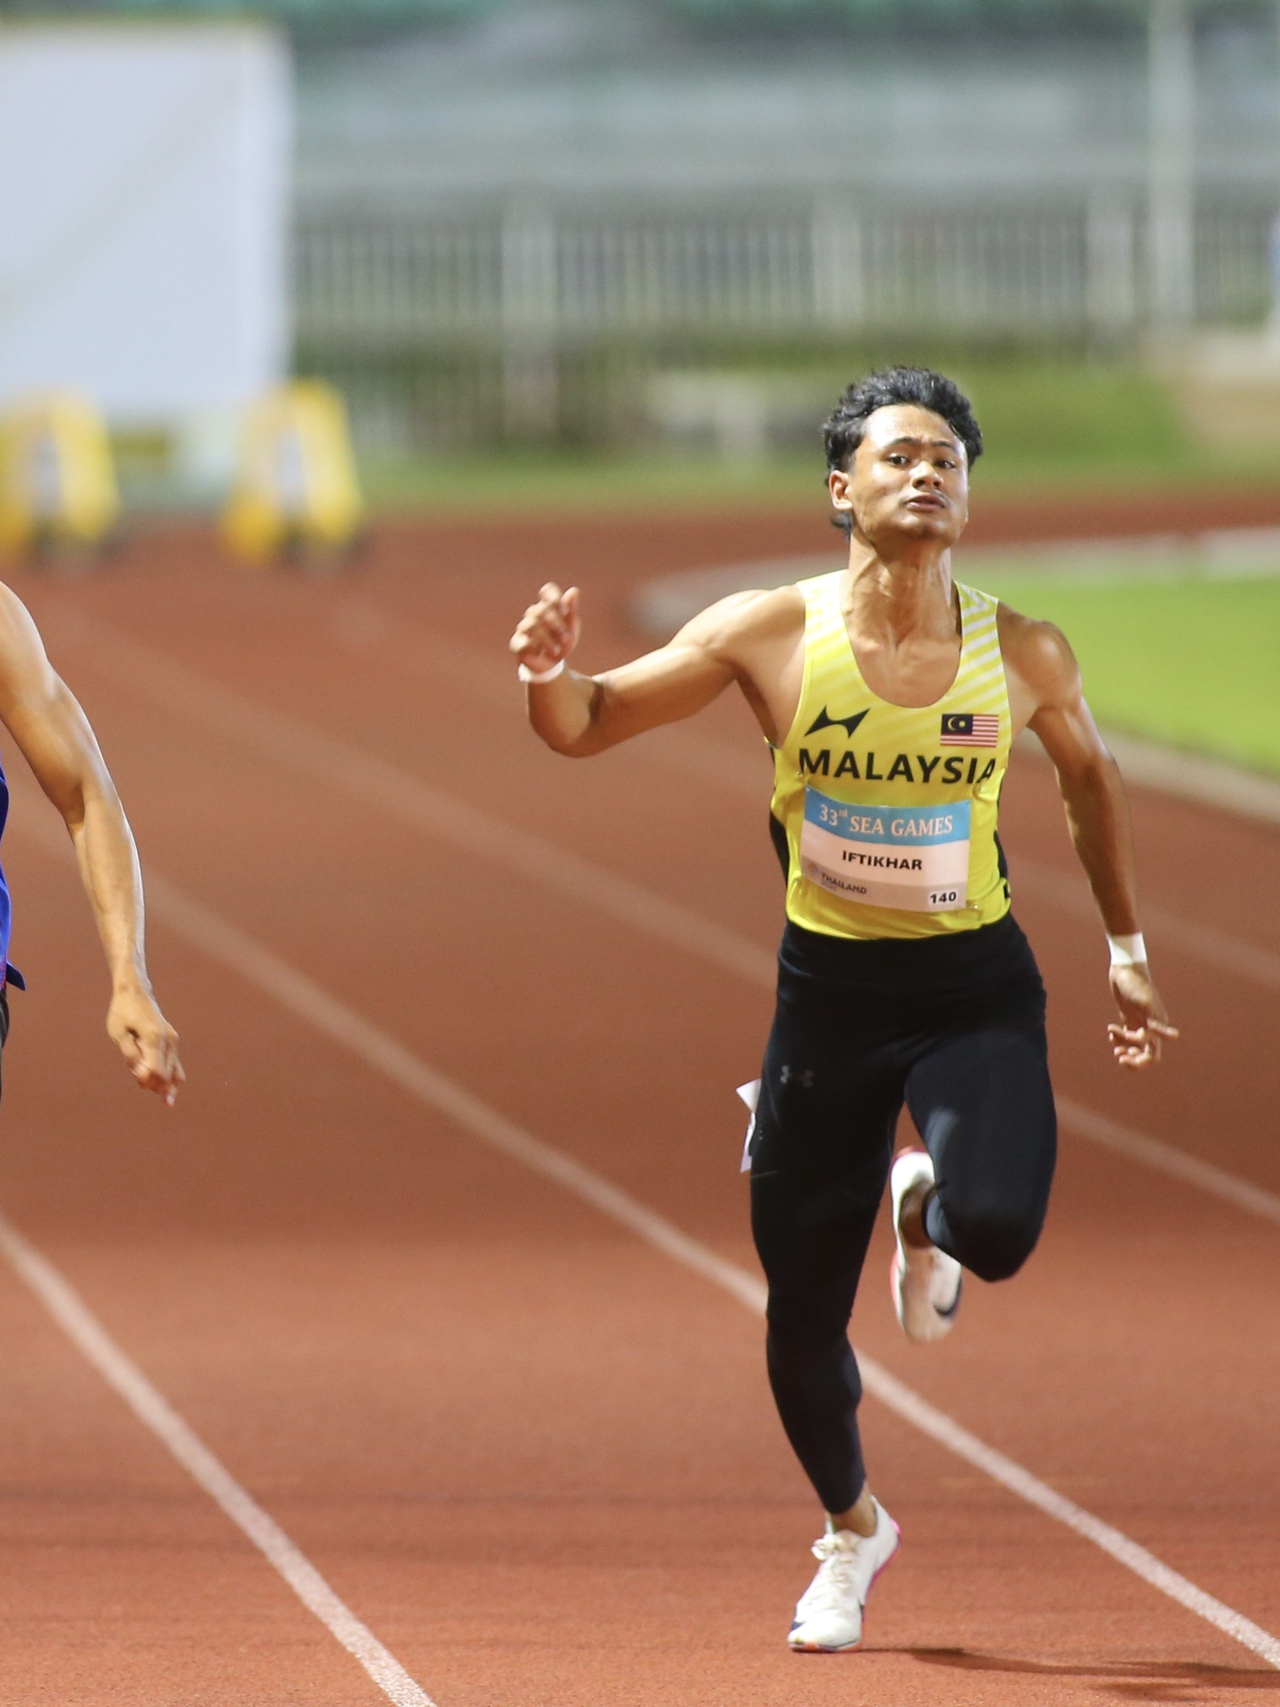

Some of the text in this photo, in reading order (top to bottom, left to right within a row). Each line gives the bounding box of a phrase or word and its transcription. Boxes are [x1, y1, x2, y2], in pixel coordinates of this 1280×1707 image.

[799, 748, 996, 784] MALAYSIA
[819, 804, 953, 837] 33rd SEA GAMES
[842, 850, 923, 871] IFTIKHAR
[822, 872, 867, 894] THAILAND
[930, 891, 957, 905] 140
